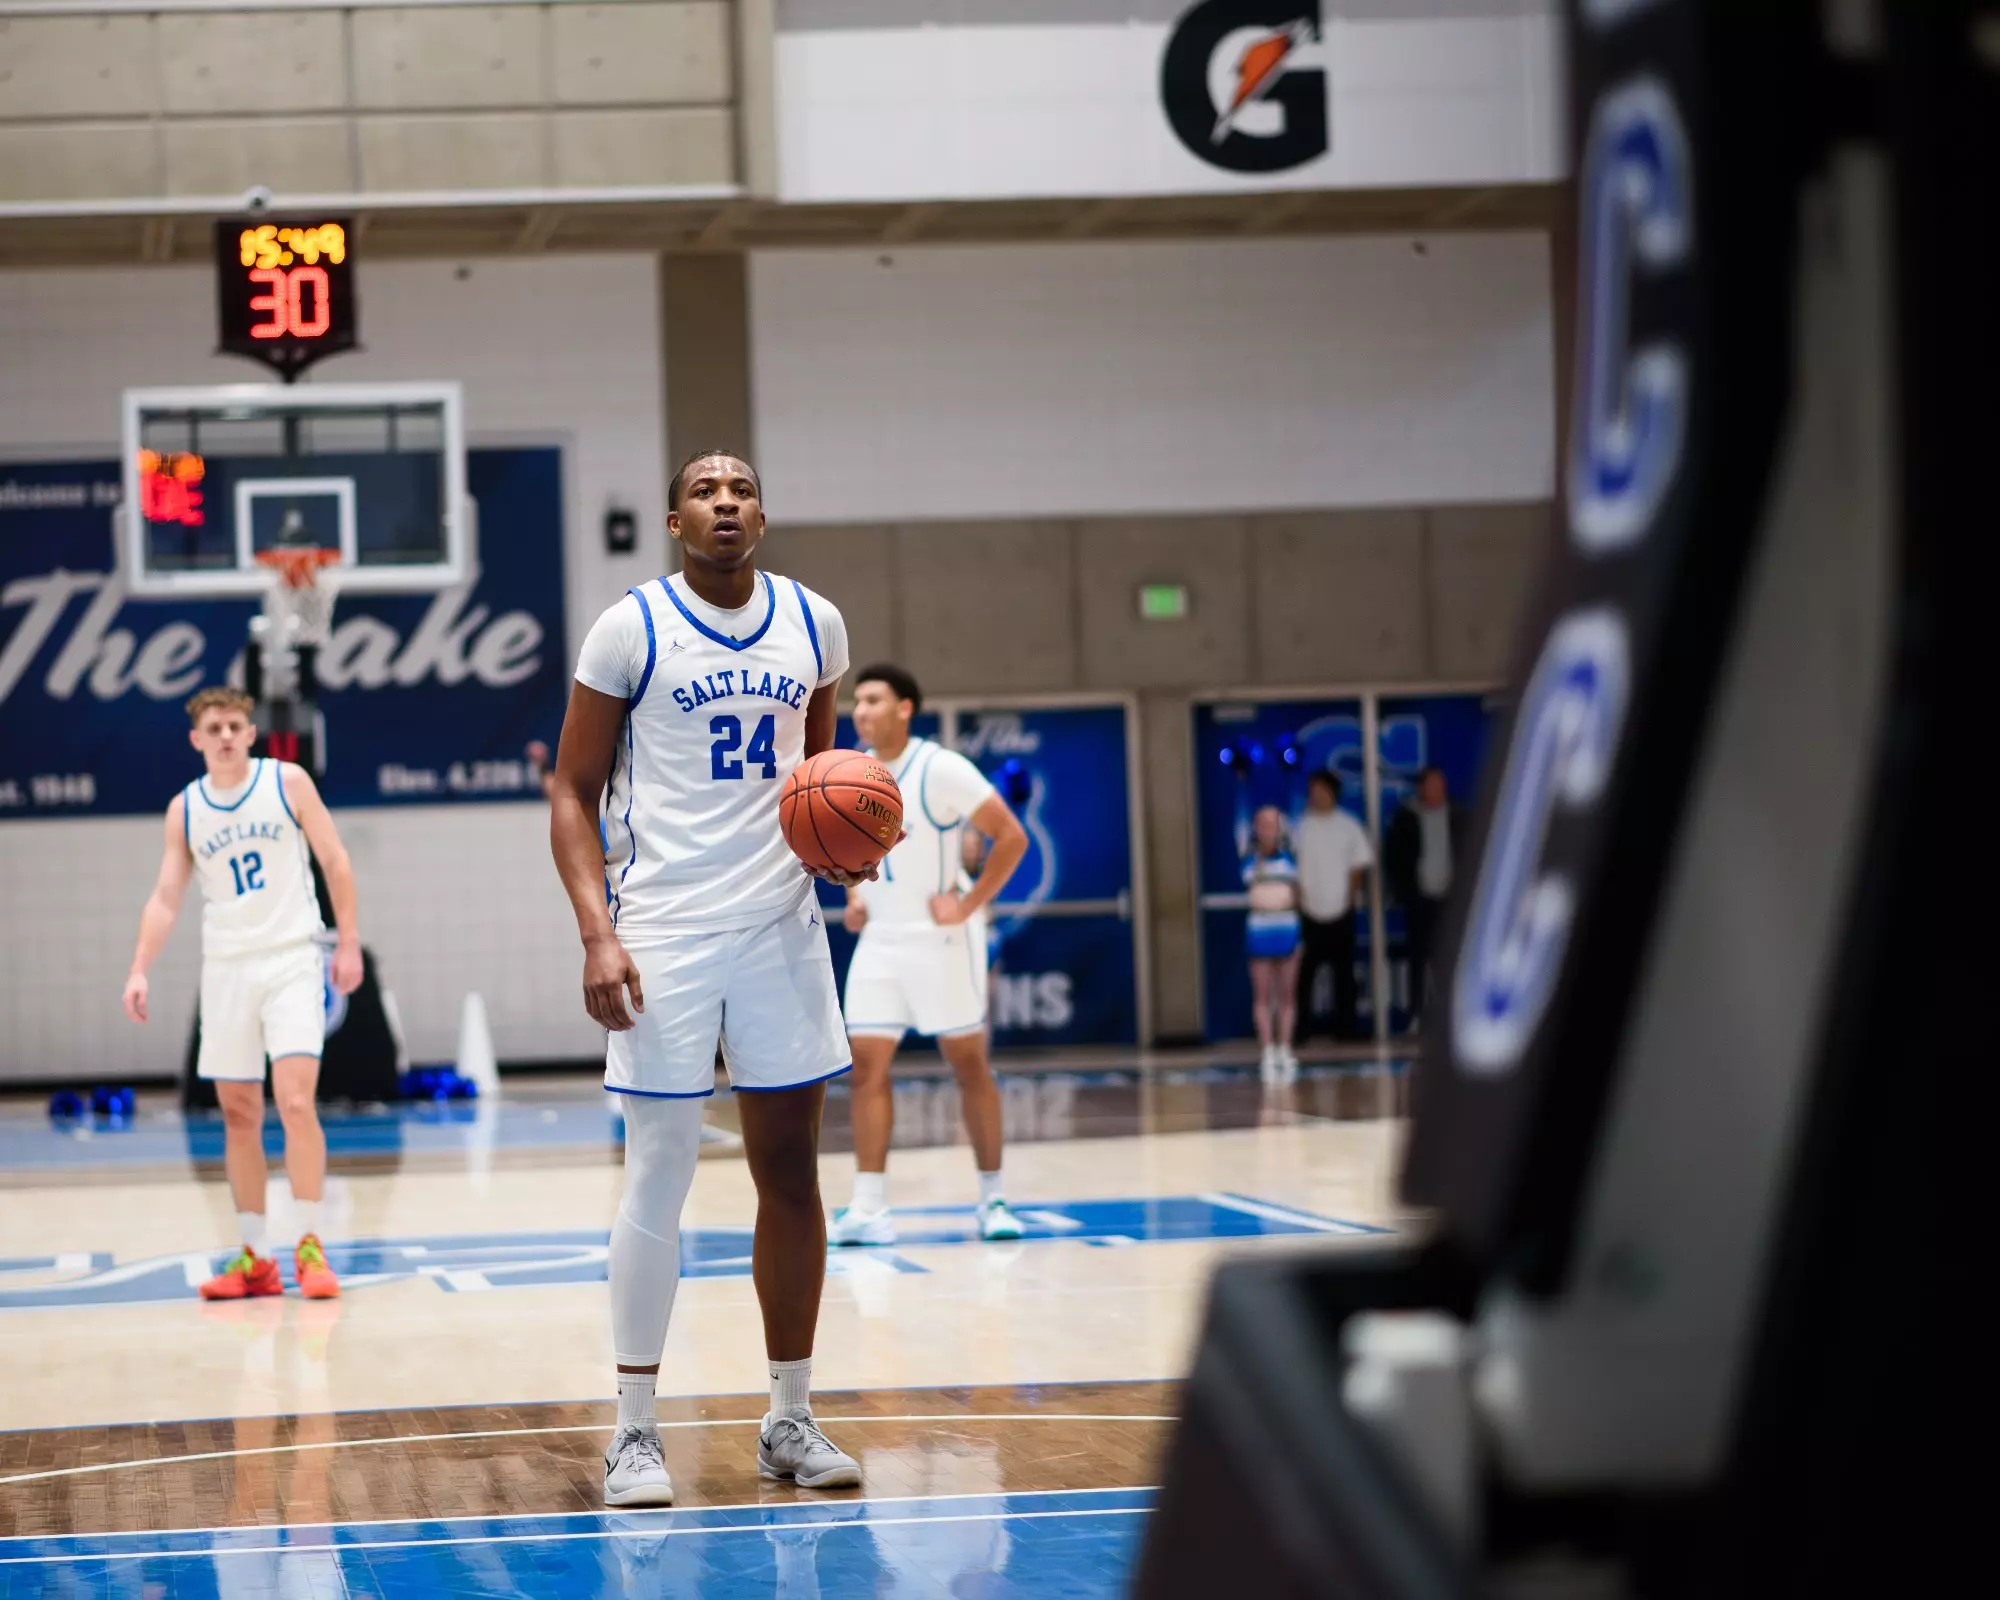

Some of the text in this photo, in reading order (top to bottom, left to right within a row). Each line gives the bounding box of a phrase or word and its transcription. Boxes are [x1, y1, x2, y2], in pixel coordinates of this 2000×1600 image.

[1160, 0, 1330, 175] G
[240, 223, 345, 269] 15:49
[249, 267, 330, 338] 30
[0, 566, 206, 700] The
[672, 669, 808, 713] SALT LAKE
[709, 714, 777, 781] 24
[199, 821, 284, 860] SALT LAKE
[229, 850, 266, 896] 12
